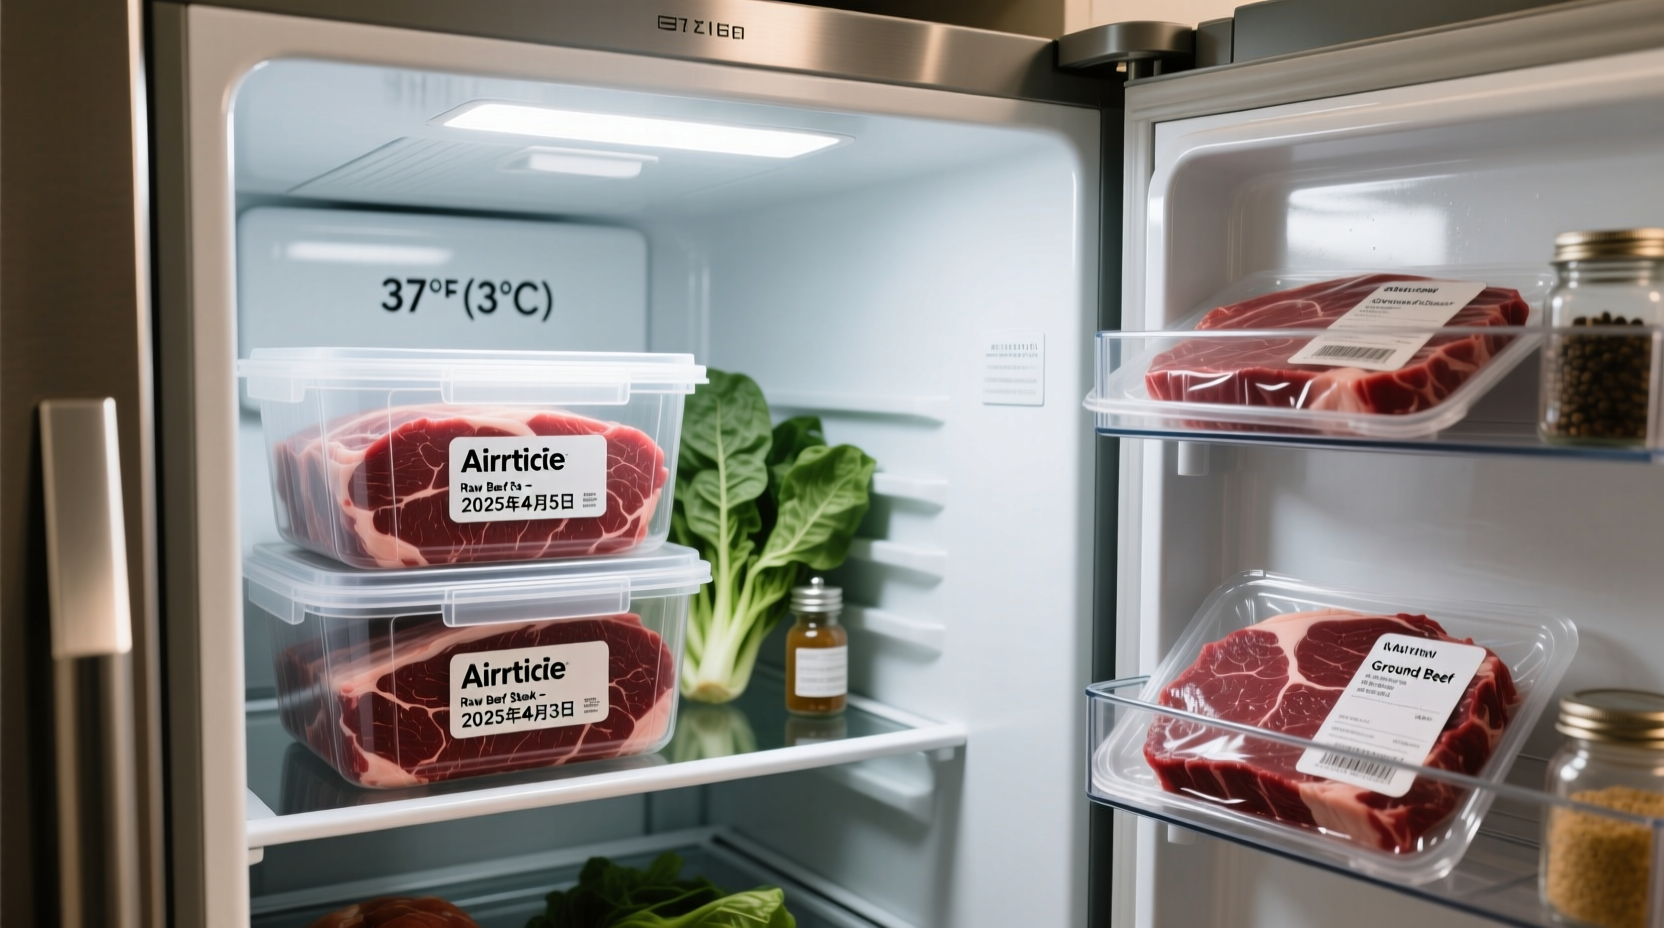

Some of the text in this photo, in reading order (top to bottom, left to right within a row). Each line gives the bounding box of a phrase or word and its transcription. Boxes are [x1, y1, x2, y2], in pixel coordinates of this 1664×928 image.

[460, 482, 483, 493] Raw
[461, 493, 574, 513] 2025年4月5日
[1371, 660, 1456, 685] Ground Beef
[460, 697, 483, 708] Raw
[461, 700, 574, 729] 2025年4月3日
